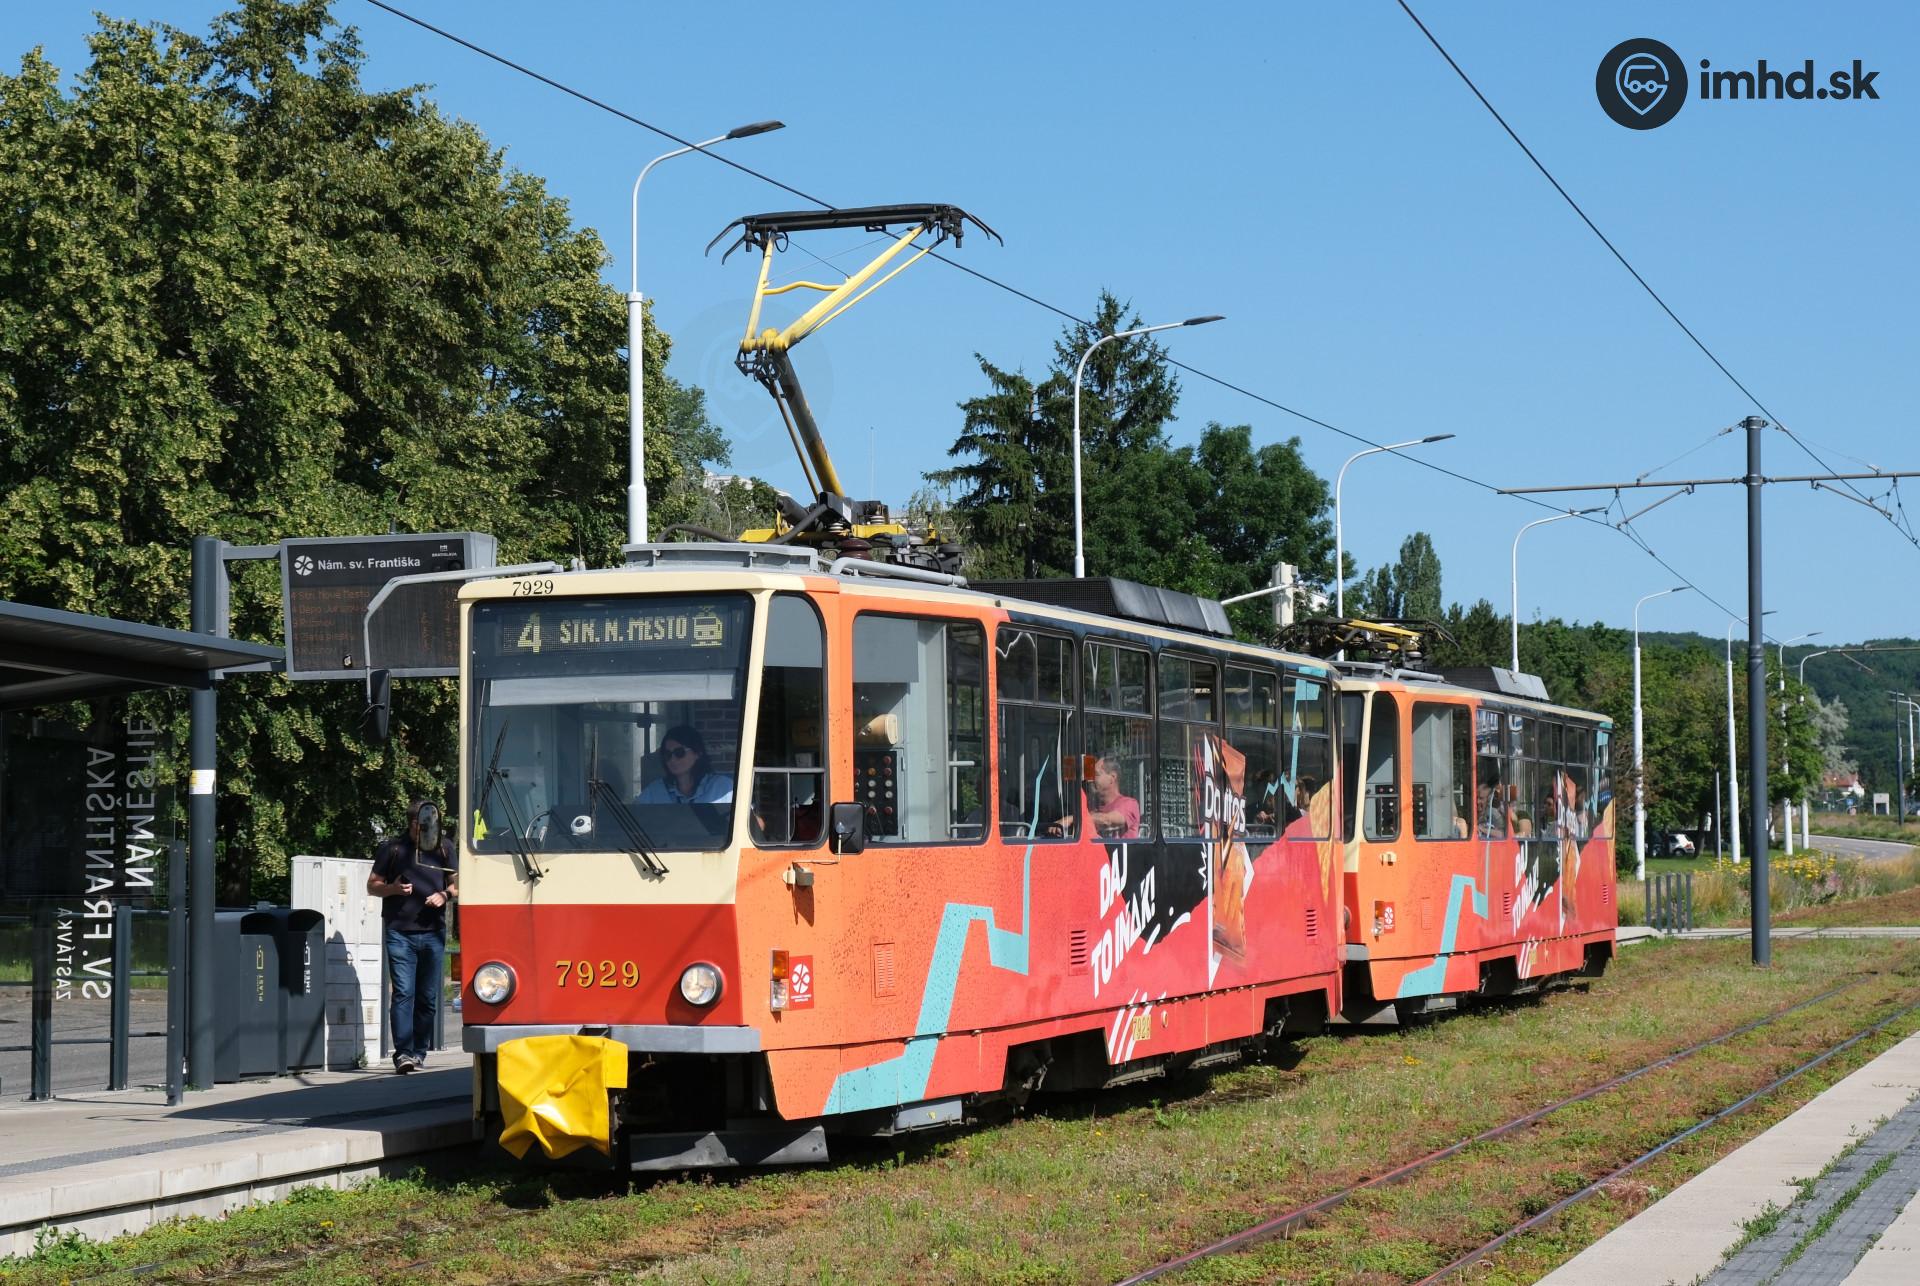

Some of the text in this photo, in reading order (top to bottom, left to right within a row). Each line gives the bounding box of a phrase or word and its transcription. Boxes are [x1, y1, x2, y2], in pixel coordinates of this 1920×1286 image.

[317, 556, 421, 571] Nám. sv. Františka
[512, 580, 554, 596] 7929
[517, 612, 542, 653] 4
[628, 615, 688, 641] MESTO
[1099, 843, 1128, 919] DAJ
[555, 960, 640, 988] 7929
[1091, 929, 1113, 999] TO
